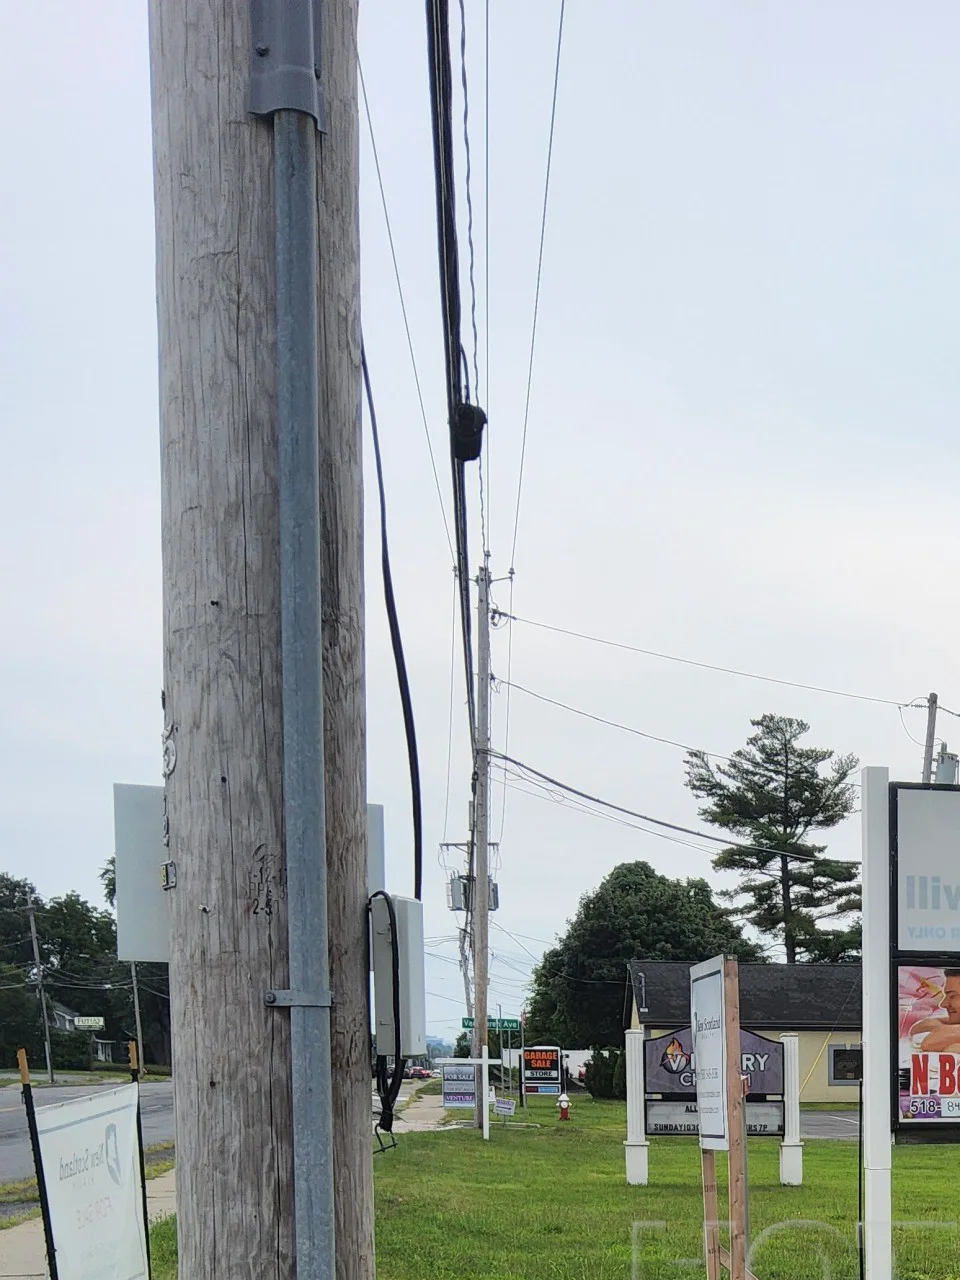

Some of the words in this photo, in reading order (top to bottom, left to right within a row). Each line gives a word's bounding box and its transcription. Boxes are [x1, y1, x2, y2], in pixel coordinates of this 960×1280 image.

[503, 1020, 517, 1028] Ave
[524, 1051, 557, 1060] GARAGE
[530, 1060, 551, 1068] SALE
[911, 1053, 929, 1096] N
[910, 1100, 941, 1114] 518-
